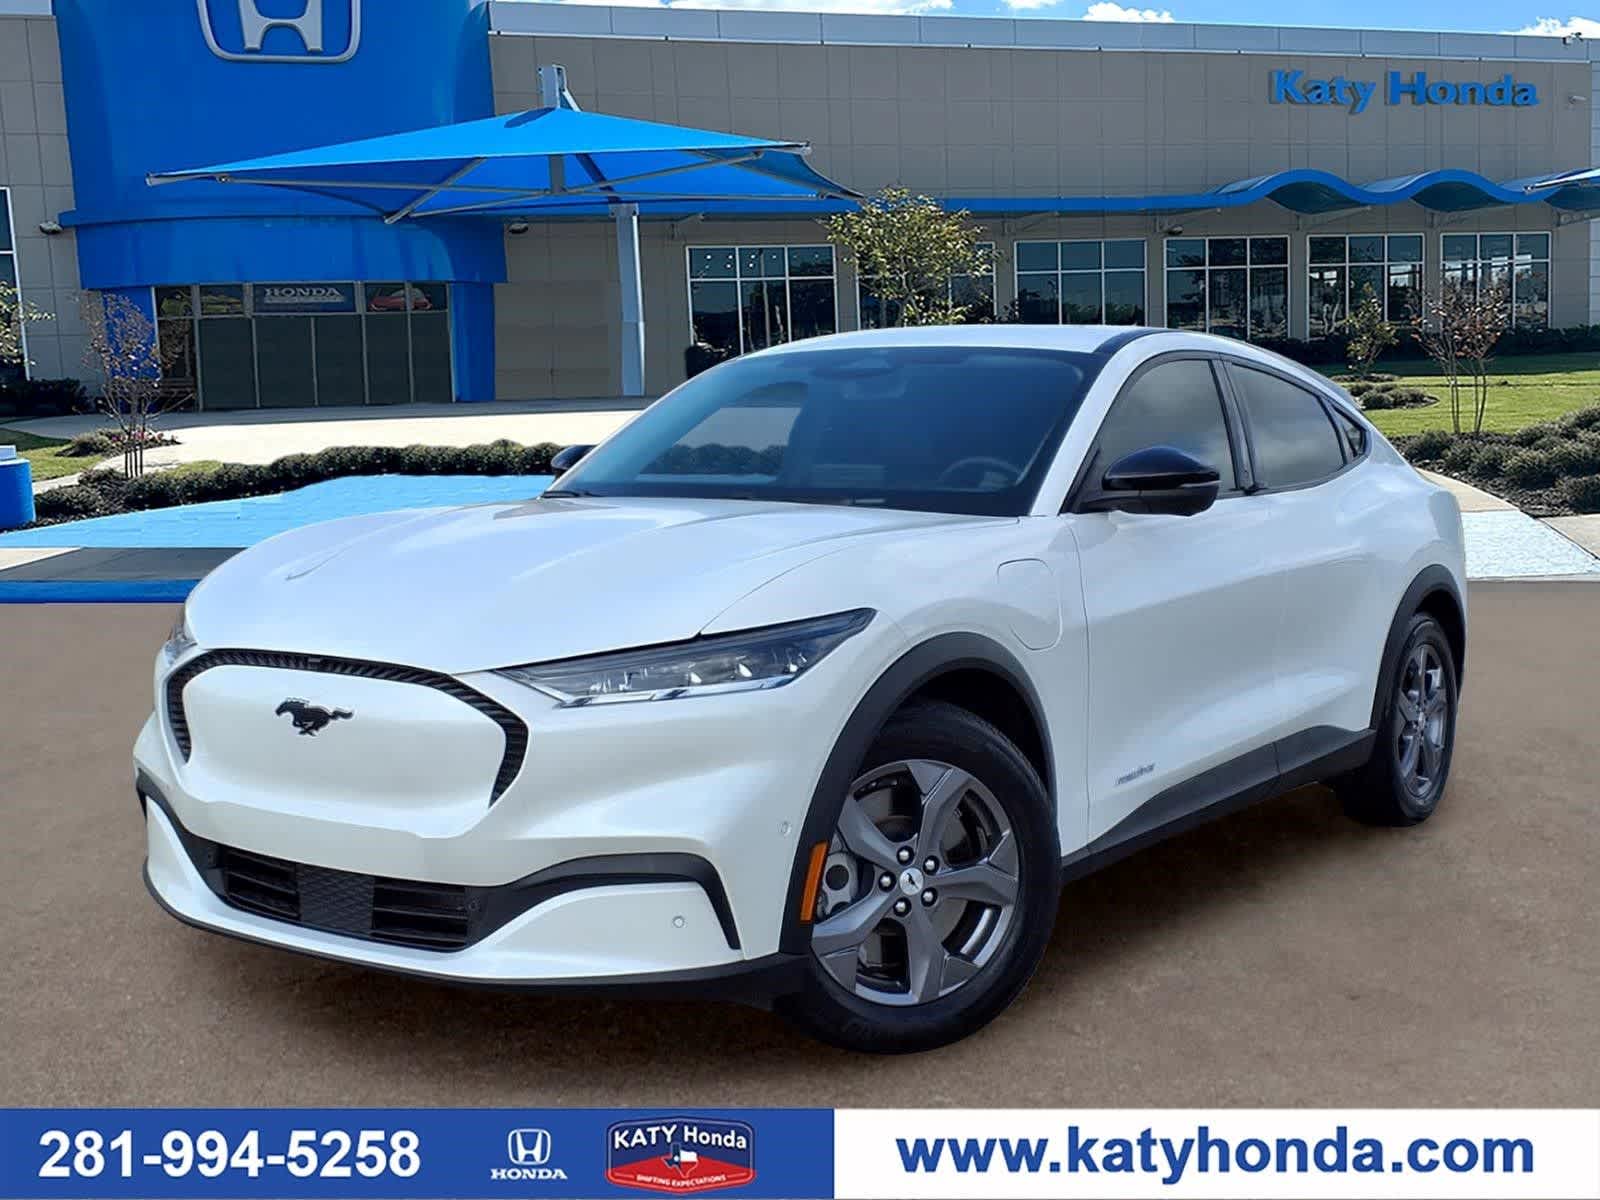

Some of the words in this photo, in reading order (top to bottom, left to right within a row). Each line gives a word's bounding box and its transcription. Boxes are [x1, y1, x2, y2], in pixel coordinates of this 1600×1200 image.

[1271, 69, 1377, 114] Katy
[1386, 70, 1541, 107] Honda
[264, 287, 342, 297] HONDA
